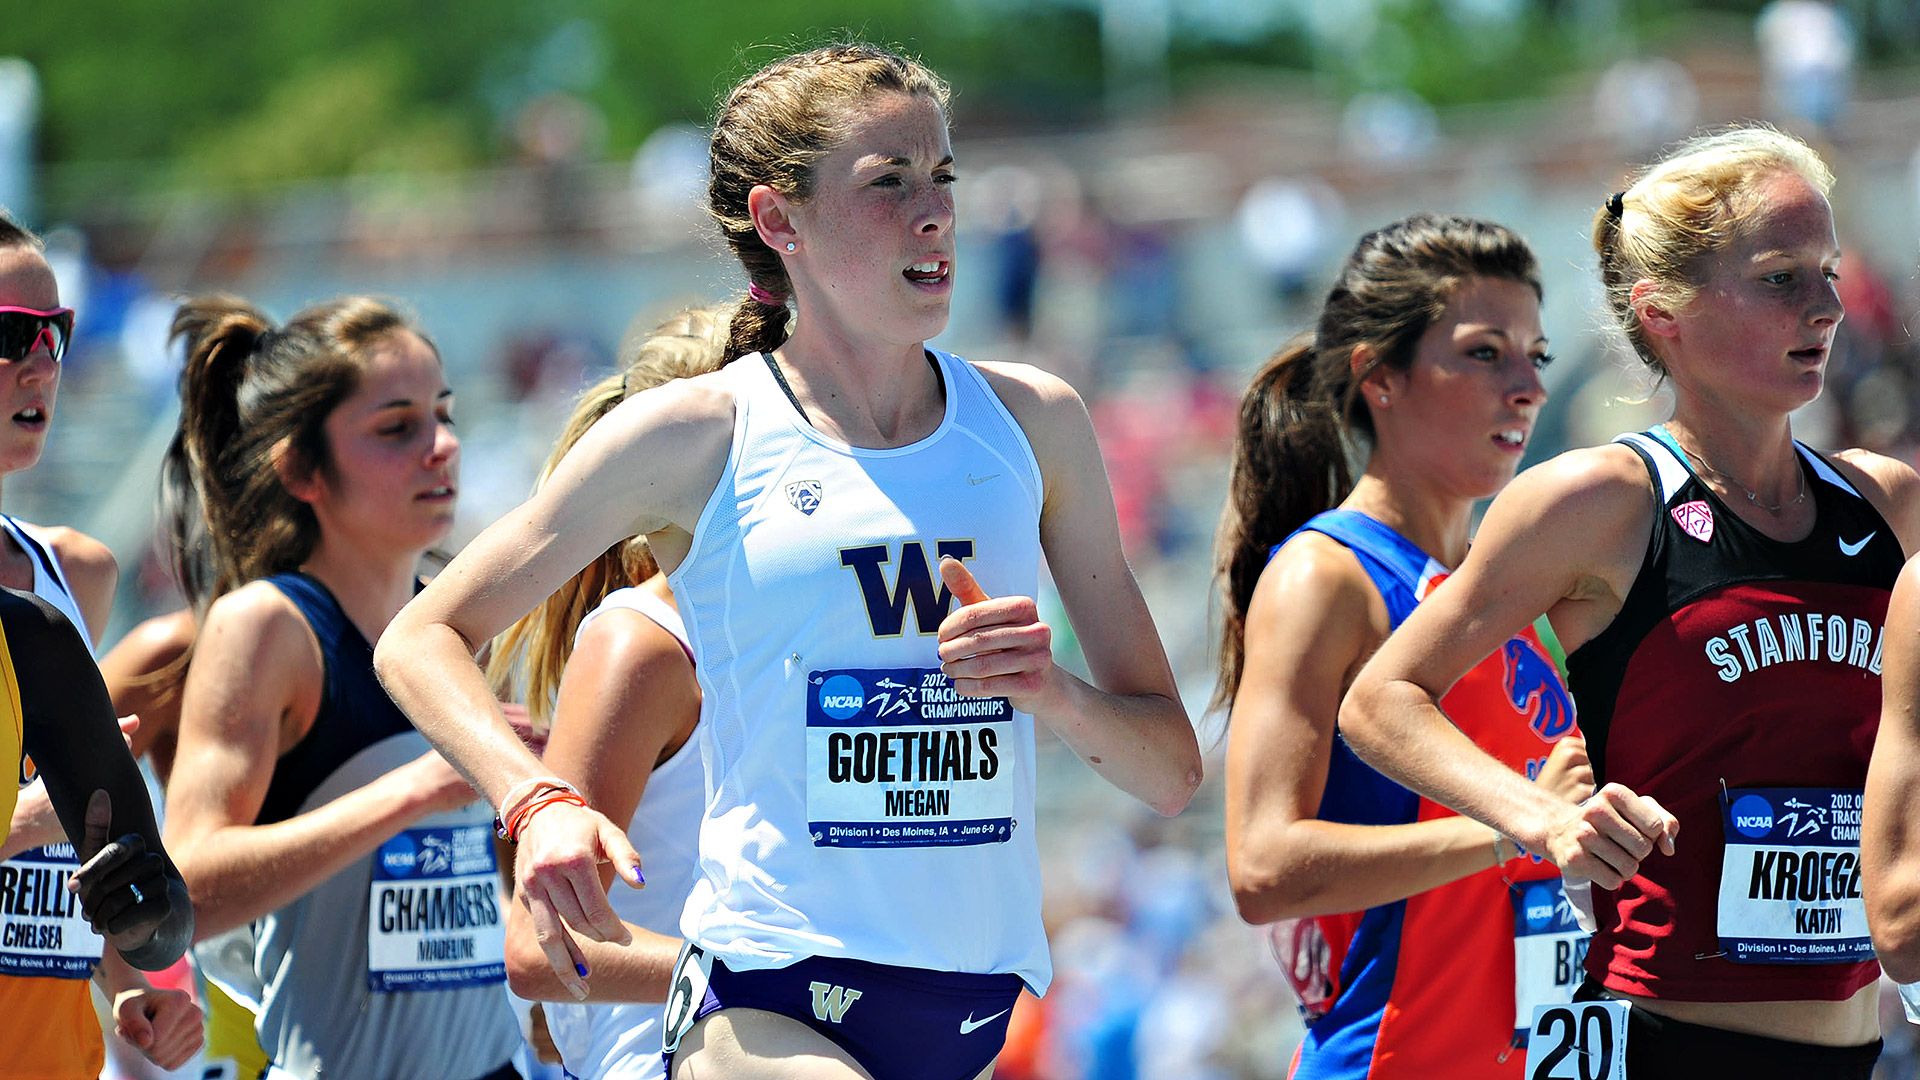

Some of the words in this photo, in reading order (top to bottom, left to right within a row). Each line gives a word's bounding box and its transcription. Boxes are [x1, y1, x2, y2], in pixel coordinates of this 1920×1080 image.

[785, 480, 822, 504] PAC
[1675, 502, 1712, 529] PAC
[1689, 519, 1711, 536] 12
[837, 538, 976, 638] W
[921, 673, 948, 687] 2012
[823, 695, 864, 709] NCAA
[920, 687, 958, 703] TRACK
[920, 700, 1005, 719] CHAMPIONSHIPS
[828, 728, 999, 784] GOETHALS
[885, 789, 951, 817] MEGAN
[1831, 794, 1853, 809] 2012
[1736, 816, 1773, 829] NCAA
[1831, 810, 1862, 825] TRACK
[829, 826, 868, 837] Division
[882, 827, 900, 837] Des
[902, 826, 937, 838] Moines,
[939, 826, 949, 836] IA
[960, 825, 981, 835] June
[981, 824, 995, 834] 6-9
[1831, 826, 1862, 841] CHAM
[43, 843, 78, 858] CHAMP
[1749, 850, 1863, 902] KROEGE
[381, 882, 498, 932] CHAMBERS
[1796, 908, 1842, 934] KATHY
[2, 922, 62, 950] CHELSEA
[1737, 942, 1776, 953] Division
[1789, 944, 1807, 954] Des
[1808, 944, 1837, 954] Moines,
[1838, 943, 1846, 953] IA
[1853, 942, 1870, 952] June
[417, 937, 474, 961] MADELINE
[1555, 935, 1591, 986] BA
[809, 981, 863, 1024] W
[1532, 1005, 1614, 1080] 20
